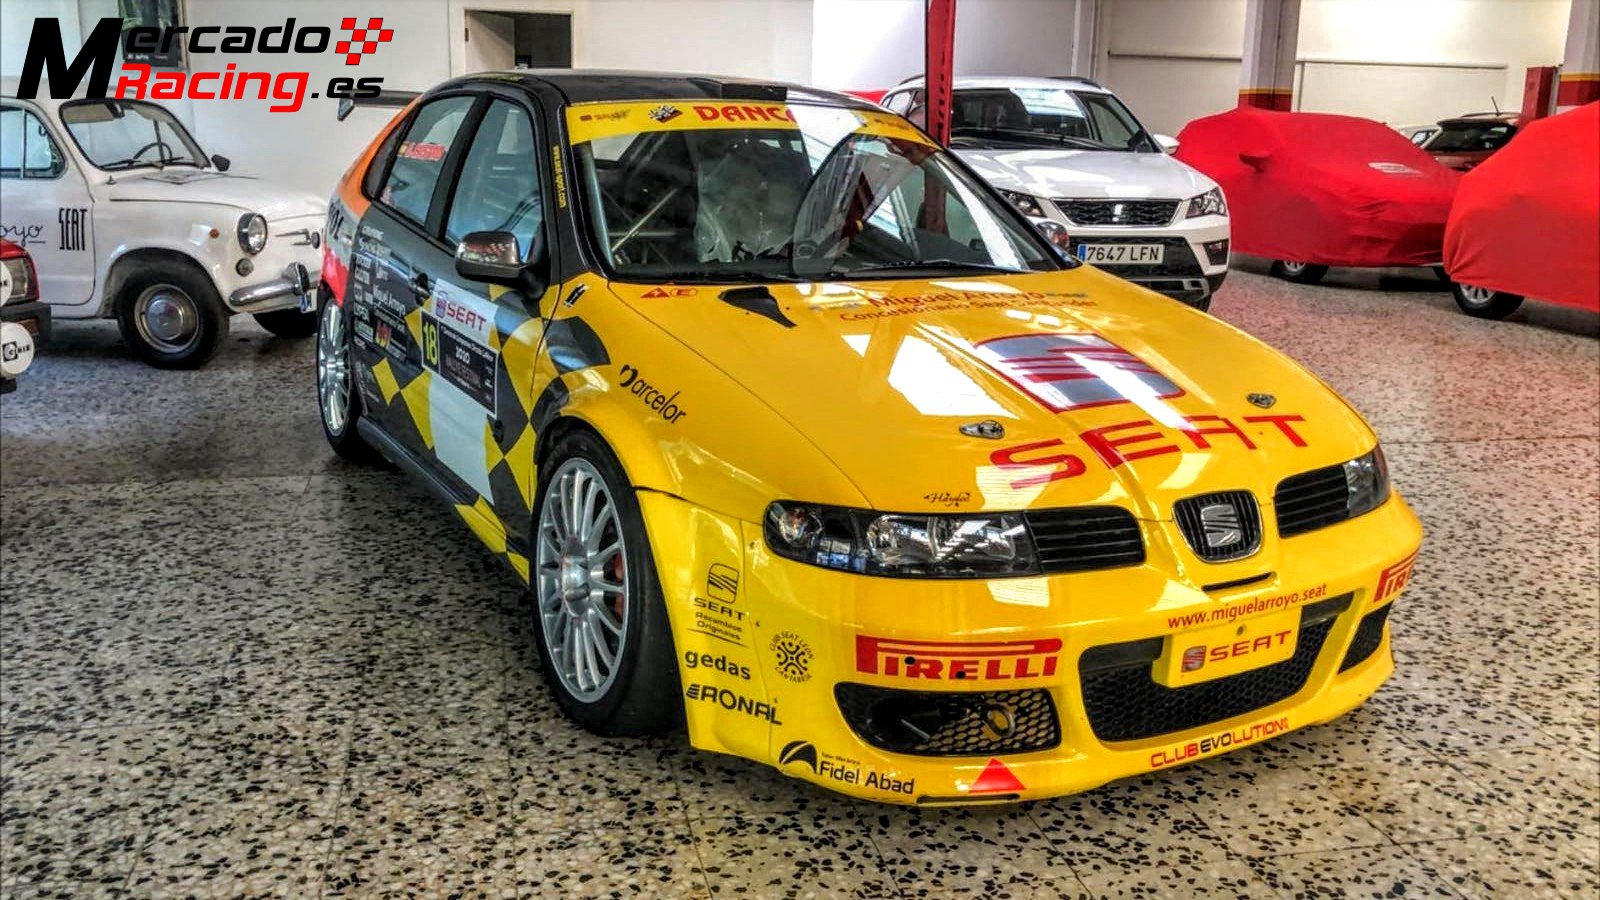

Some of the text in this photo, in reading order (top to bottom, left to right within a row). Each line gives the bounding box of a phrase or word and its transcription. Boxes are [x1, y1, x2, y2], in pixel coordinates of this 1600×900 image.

[58, 208, 88, 251] SEAT
[1087, 246, 1159, 261] 7647 LFN
[447, 301, 487, 331] SEAT
[423, 321, 438, 365] 18
[989, 414, 1309, 490] SEAT
[693, 597, 746, 621] SEAT
[695, 611, 743, 633] Recambios
[1167, 583, 1327, 628] www.miguelarroyo.seat
[855, 634, 1063, 680] PIRELLI
[1209, 630, 1292, 662] SEAT
[684, 650, 751, 680] gedas
[700, 685, 783, 726] RONAL
[819, 761, 915, 795] Fidel Abad
